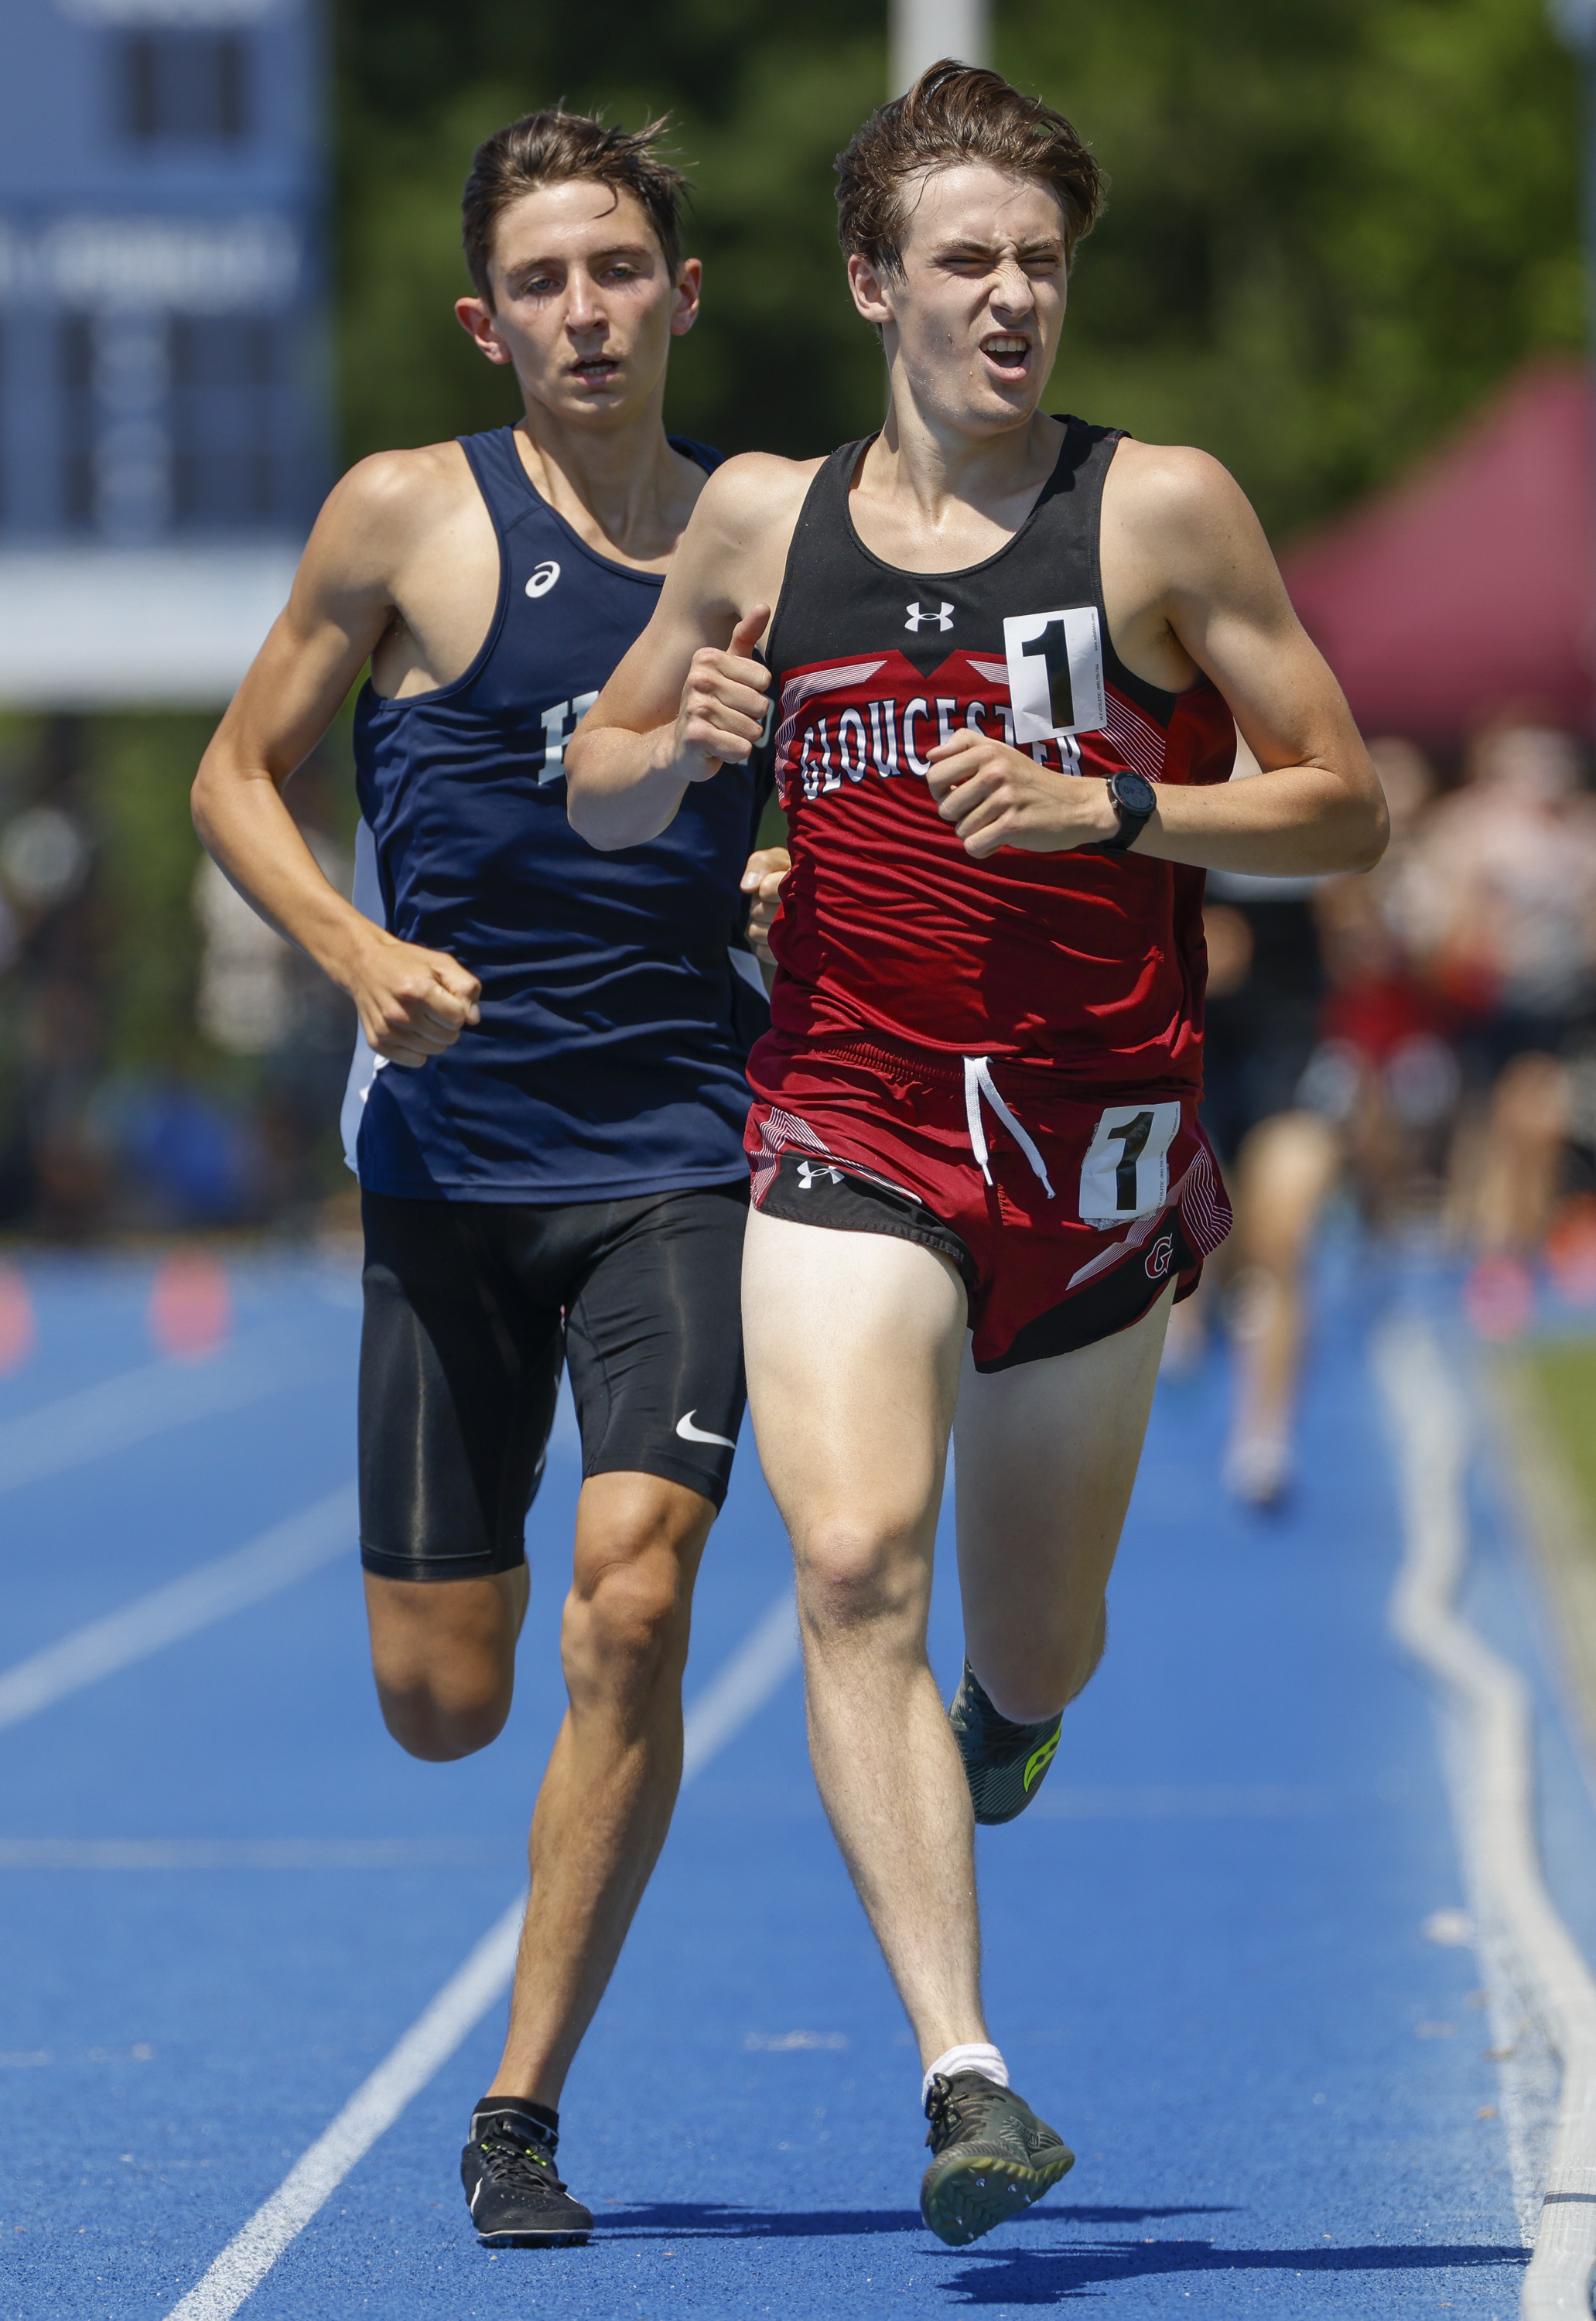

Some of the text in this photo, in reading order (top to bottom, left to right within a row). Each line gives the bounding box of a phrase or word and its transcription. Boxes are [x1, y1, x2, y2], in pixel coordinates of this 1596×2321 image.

[1021, 619, 1075, 730] 1
[1107, 1112, 1155, 1210] 1
[1145, 1232, 1174, 1279] G
